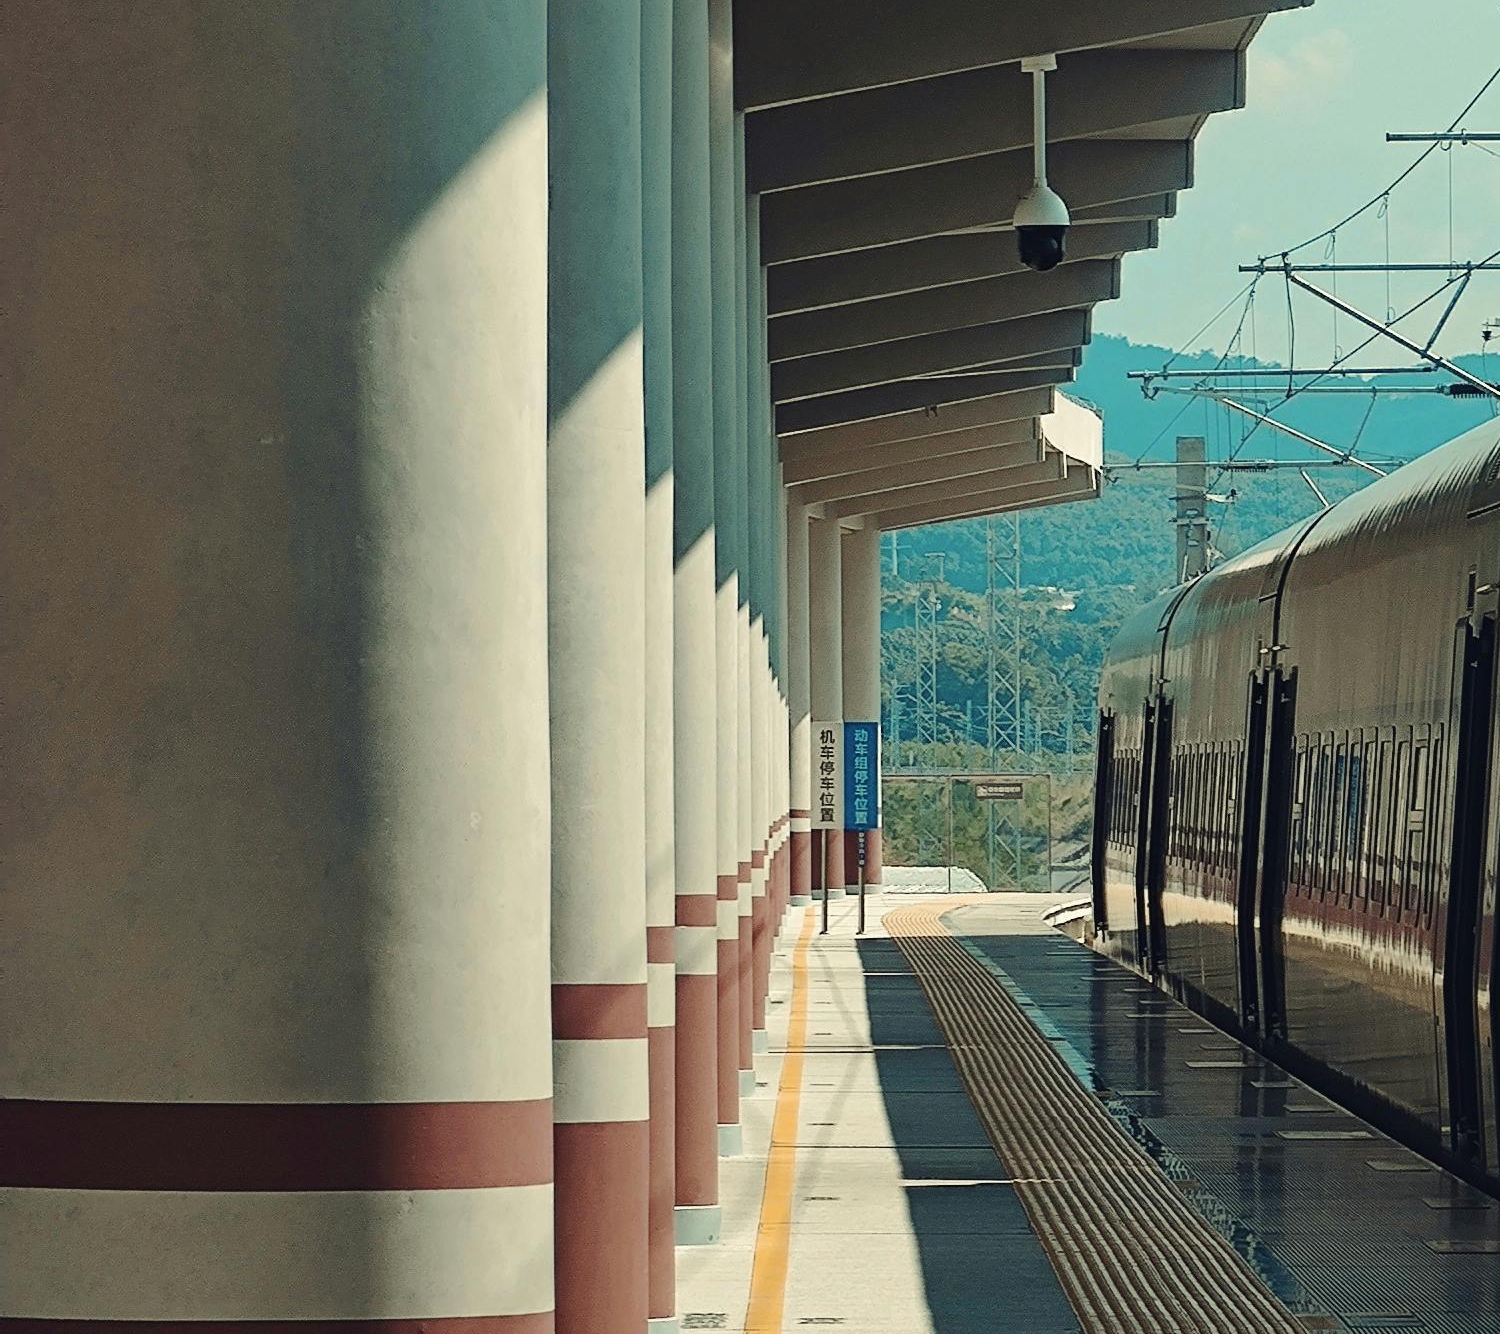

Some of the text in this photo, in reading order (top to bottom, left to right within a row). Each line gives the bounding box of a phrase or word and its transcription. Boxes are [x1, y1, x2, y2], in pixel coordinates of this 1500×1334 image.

[819, 729, 836, 823] 机车停车位置
[854, 729, 869, 825] 动车组停车位置
